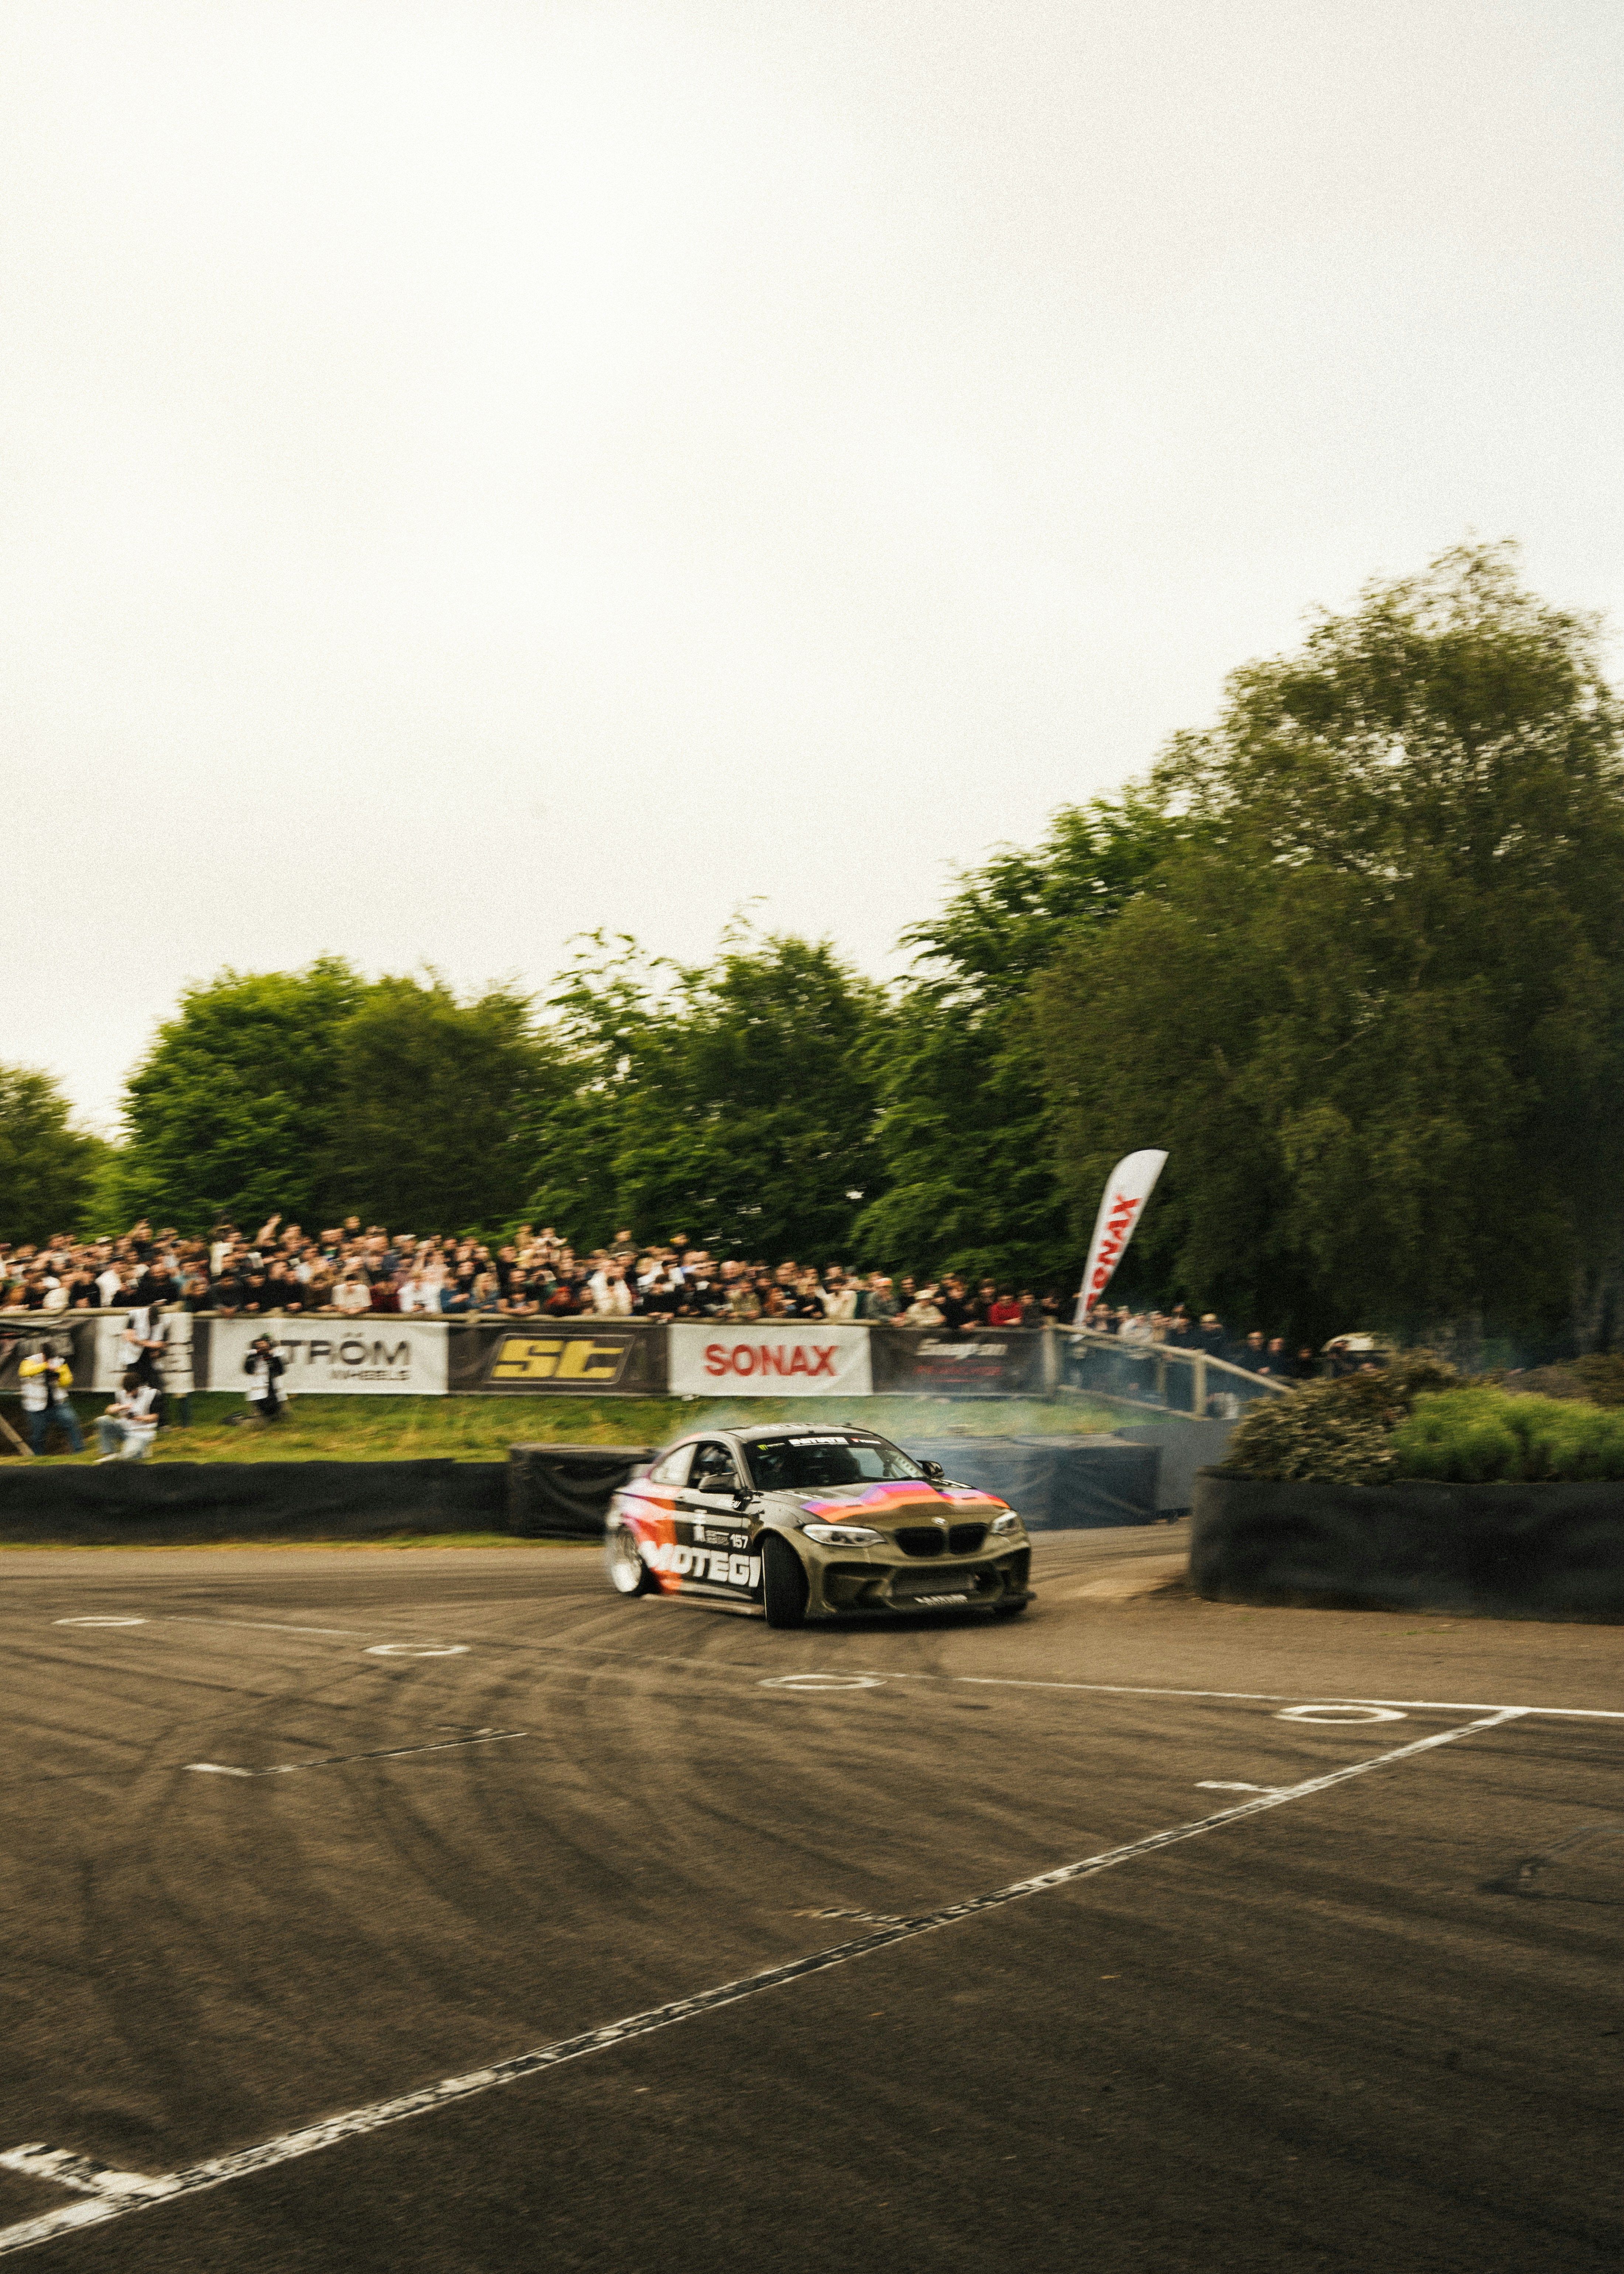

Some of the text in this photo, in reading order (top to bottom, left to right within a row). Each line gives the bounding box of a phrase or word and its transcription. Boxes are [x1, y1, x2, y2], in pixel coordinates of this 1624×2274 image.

[275, 1332, 412, 1366] TRÖM
[704, 1344, 840, 1377] SONAX
[729, 1534, 748, 1549] 157
[639, 1540, 761, 1588] MOTEGI
